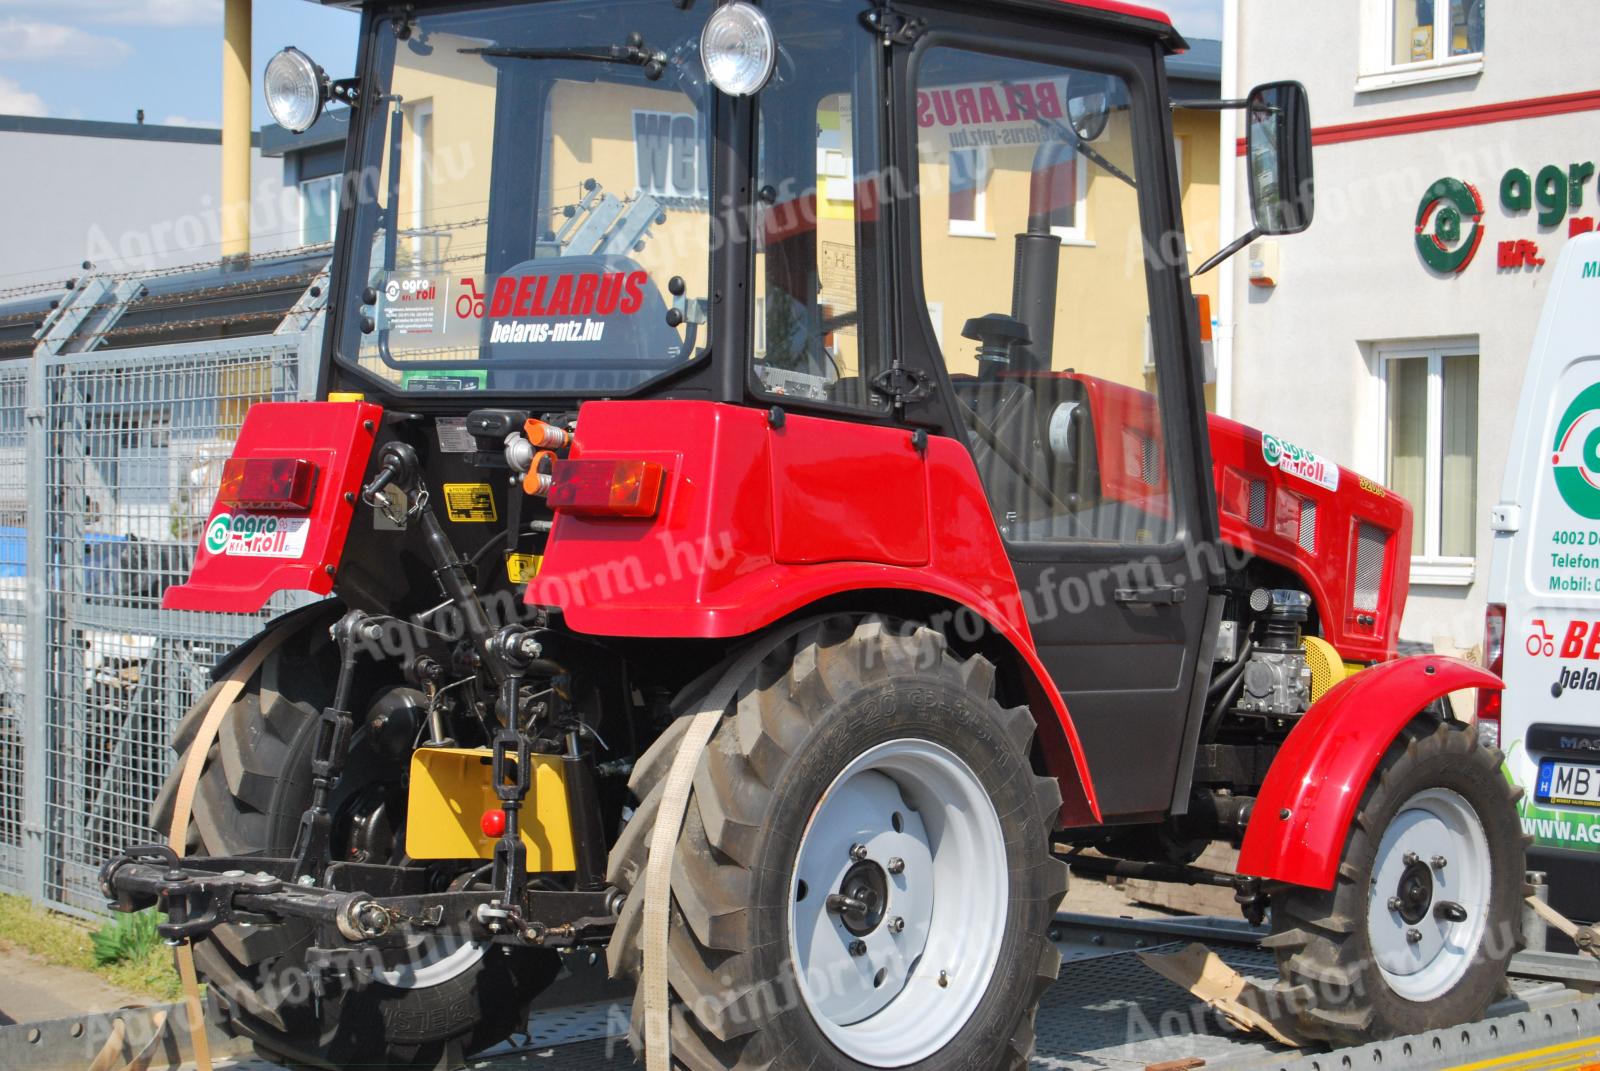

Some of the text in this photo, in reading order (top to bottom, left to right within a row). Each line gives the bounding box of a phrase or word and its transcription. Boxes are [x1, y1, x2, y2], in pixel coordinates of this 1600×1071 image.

[1500, 161, 1600, 226] agr
[1582, 261, 1600, 279] M
[488, 270, 649, 319] BELARUS
[489, 318, 605, 344] belarus-mtz.hu
[233, 517, 277, 539] agro
[1552, 530, 1600, 545] 4002 D
[252, 530, 287, 552] roll
[1551, 553, 1600, 568] Telefon
[1549, 576, 1591, 592] Mobil:
